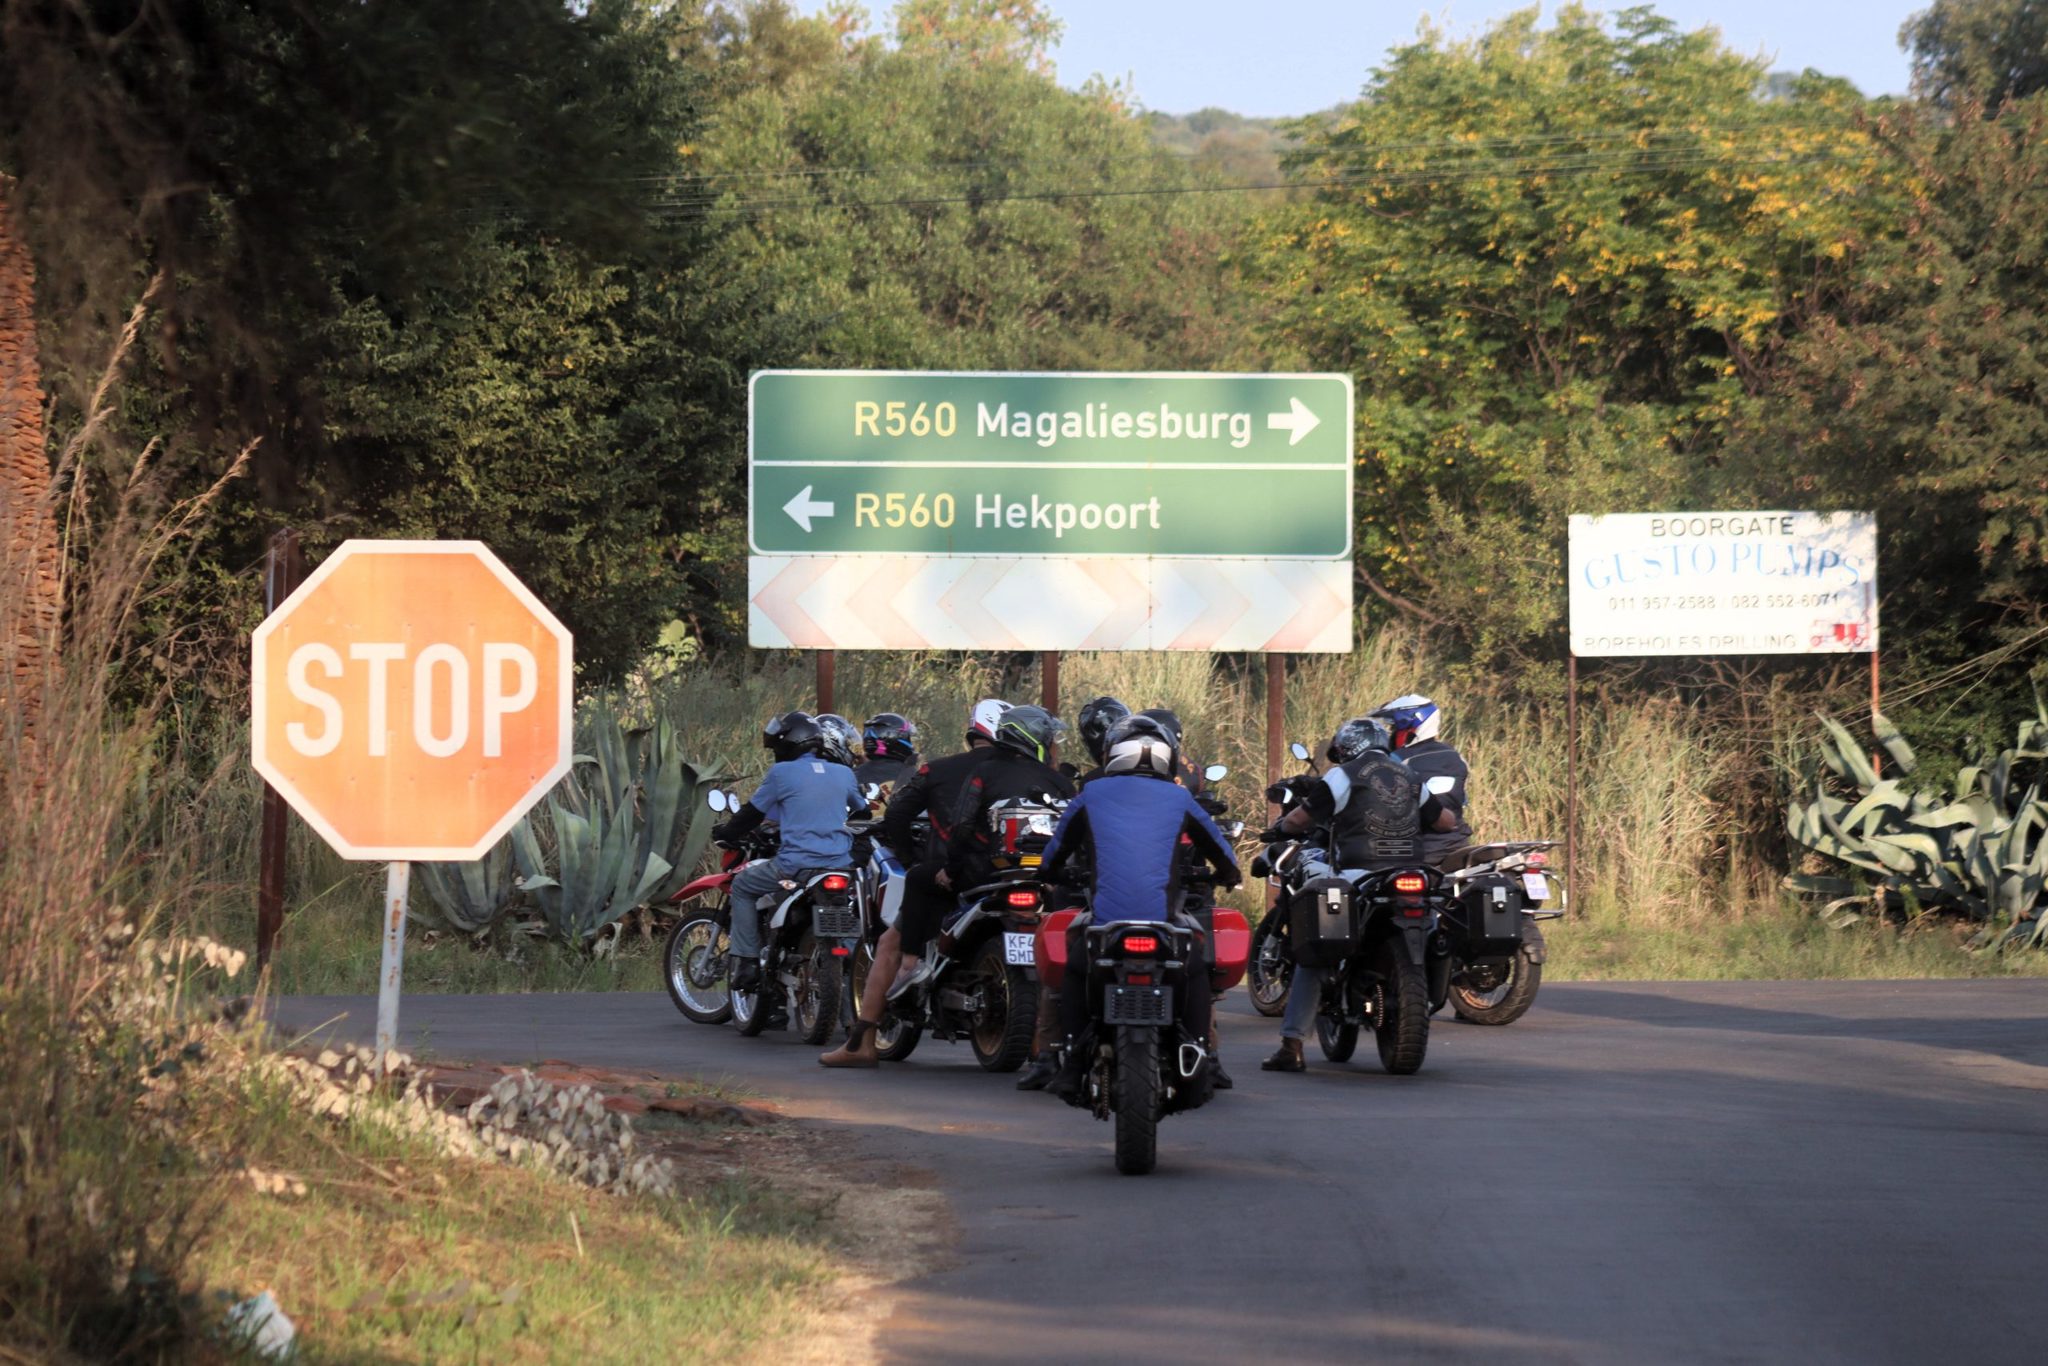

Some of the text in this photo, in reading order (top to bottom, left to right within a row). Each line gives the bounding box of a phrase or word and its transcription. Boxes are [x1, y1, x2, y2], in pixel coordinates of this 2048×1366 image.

[854, 401, 1252, 447] R560 Magaliesburg
[854, 493, 1161, 538] R560 Hekpoort
[1651, 516, 1794, 536] BOORGATE
[1583, 543, 1863, 590] GUSTO PUMPS
[1609, 596, 1634, 610] 011
[286, 642, 538, 758] STOP
